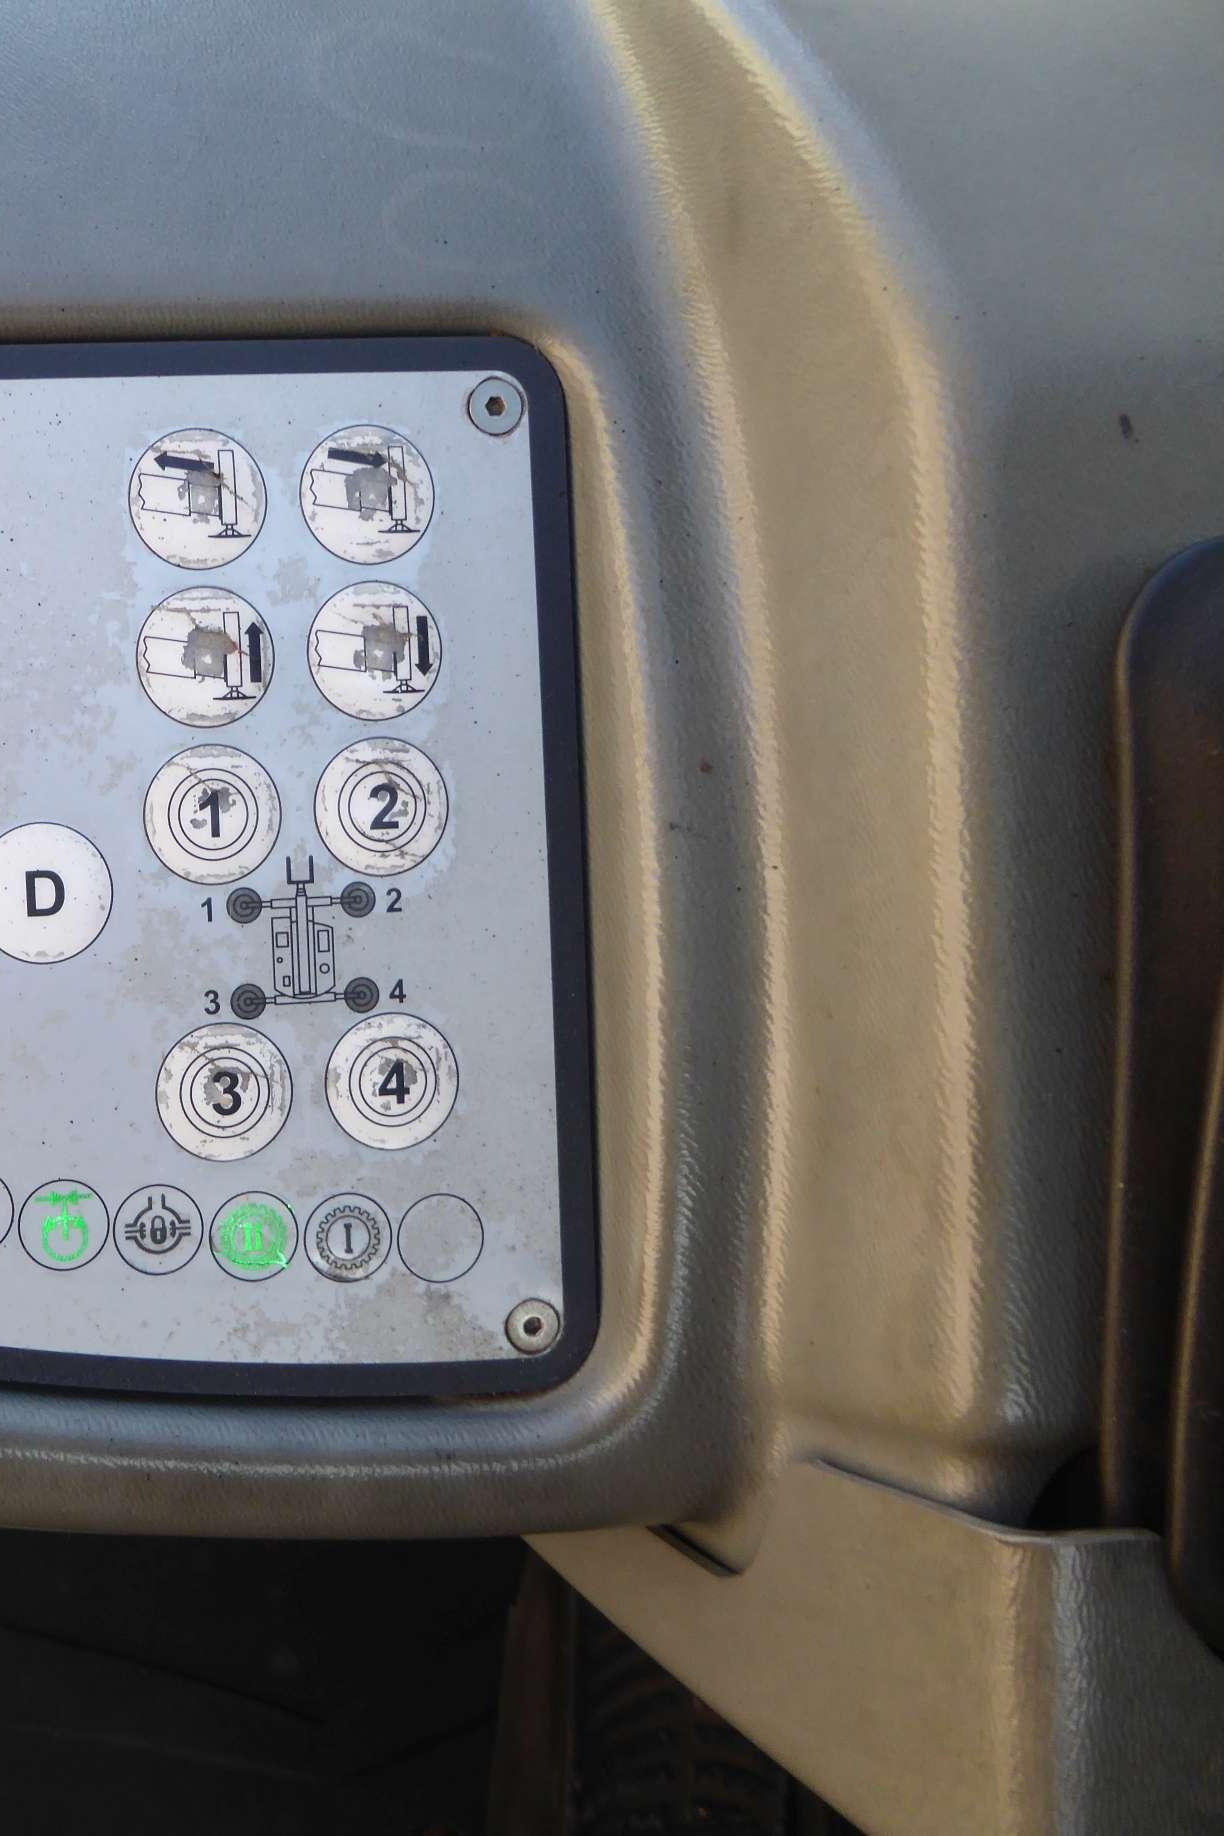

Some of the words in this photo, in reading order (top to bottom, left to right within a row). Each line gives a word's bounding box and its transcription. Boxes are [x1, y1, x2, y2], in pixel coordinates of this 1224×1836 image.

[198, 789, 221, 838] 1
[369, 783, 400, 830] 2
[25, 869, 66, 917] D
[200, 897, 213, 923] 1
[386, 887, 403, 913] 2
[203, 990, 221, 1015] 3
[388, 978, 407, 1004] 4
[211, 1070, 242, 1116] 3
[378, 1060, 411, 1105] 4
